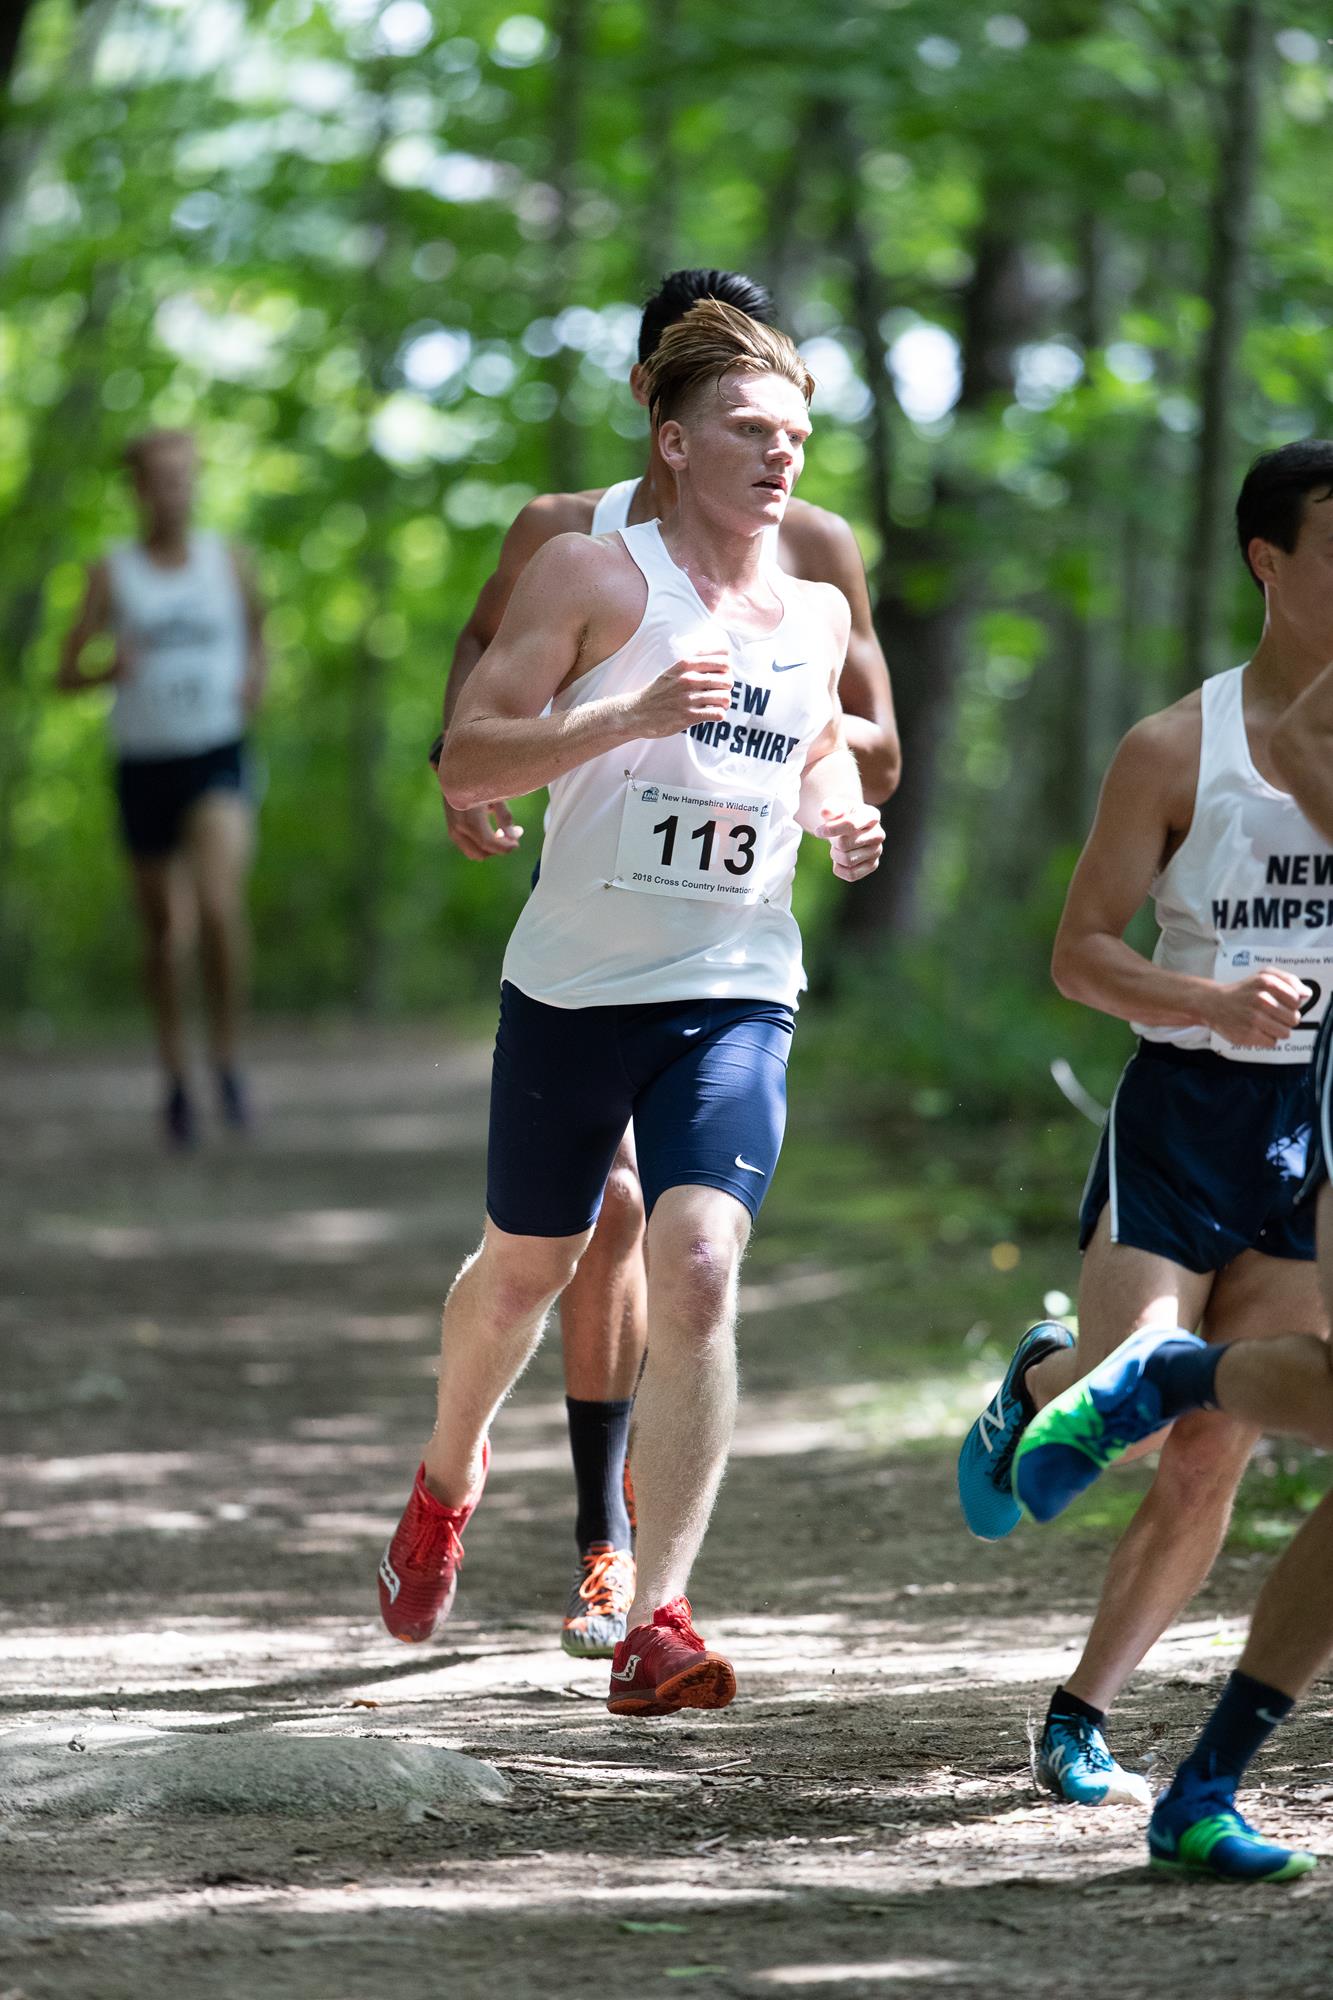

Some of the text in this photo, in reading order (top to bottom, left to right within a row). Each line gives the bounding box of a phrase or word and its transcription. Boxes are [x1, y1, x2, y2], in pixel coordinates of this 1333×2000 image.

[730, 680, 772, 716] EW
[681, 720, 800, 764] MPSHIR
[661, 793, 680, 802] New
[681, 796, 724, 808] Hampshire
[726, 801, 759, 812] Wildcats
[653, 815, 757, 876] 113
[632, 872, 652, 883] 2018
[654, 876, 679, 887] Cross
[681, 880, 715, 892] Country
[1212, 897, 1333, 930] HAMPS
[1254, 955, 1273, 963] New
[1284, 1043, 1314, 1052] Count
